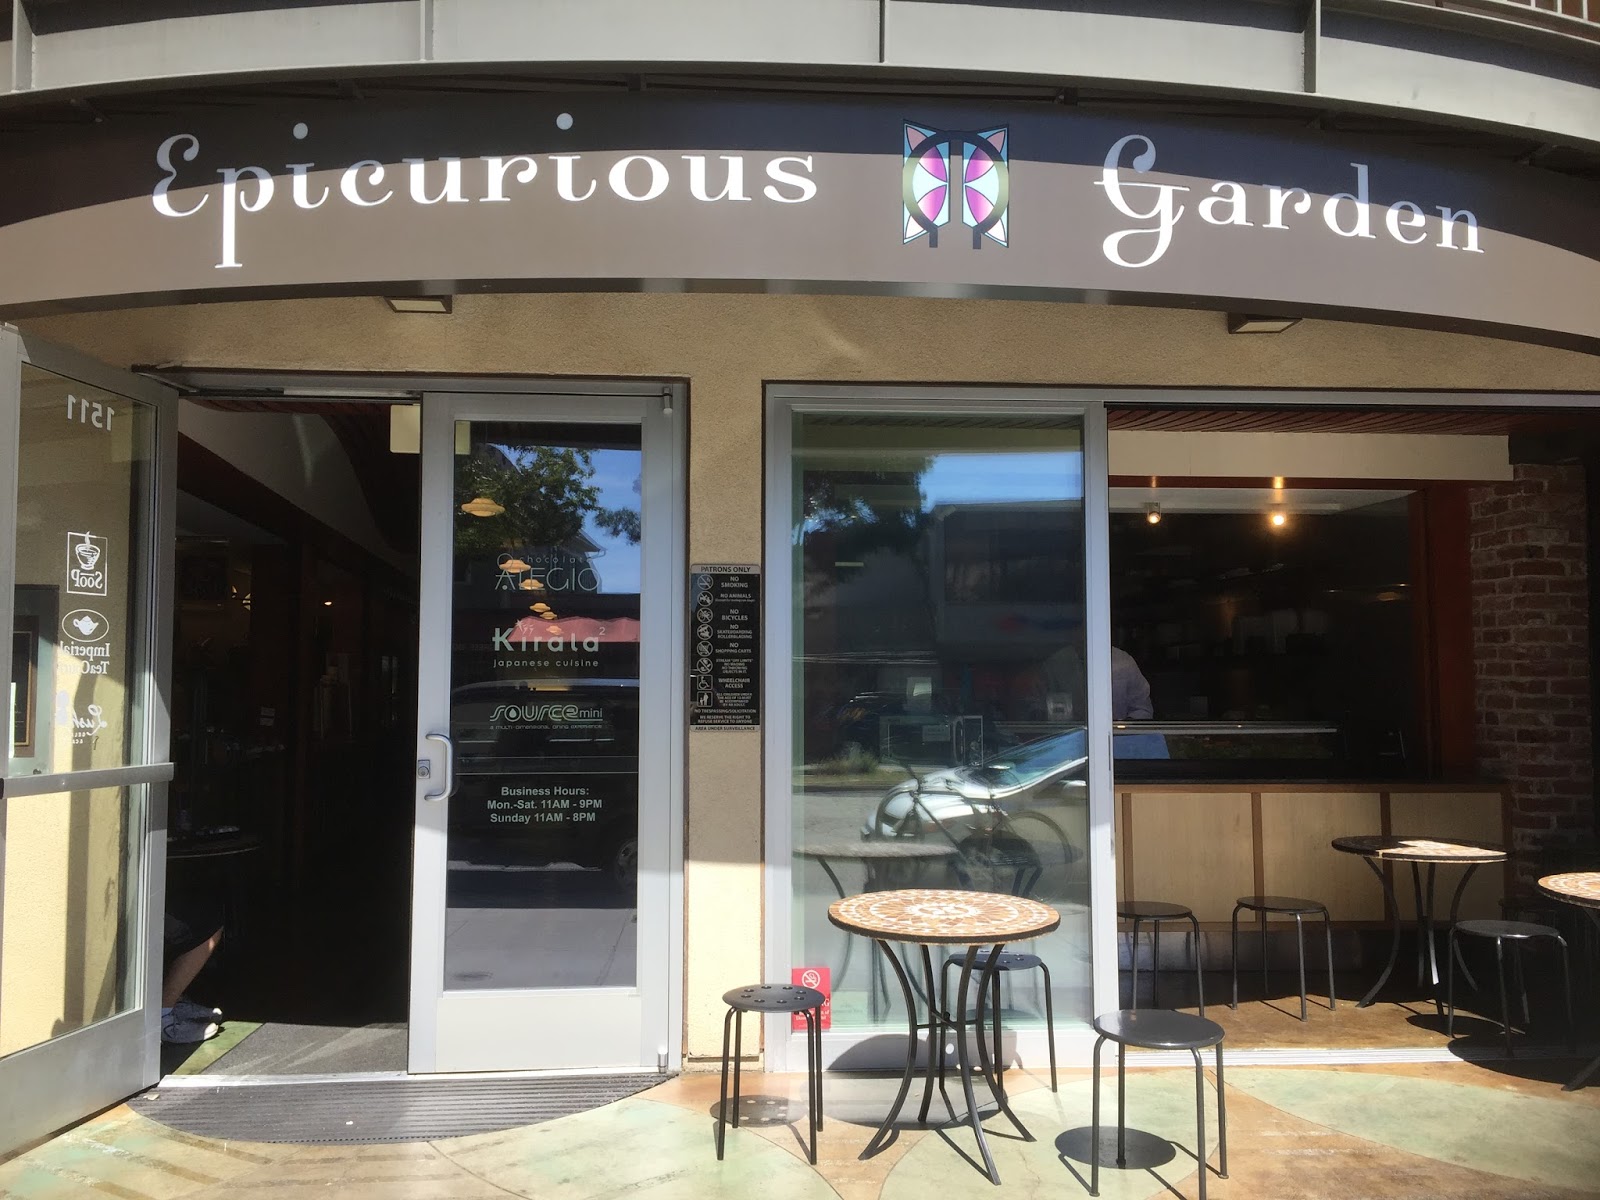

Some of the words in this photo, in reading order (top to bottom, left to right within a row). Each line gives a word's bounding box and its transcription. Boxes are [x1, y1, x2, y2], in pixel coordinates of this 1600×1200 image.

[151, 112, 819, 270] Epicurious
[1094, 133, 1485, 269] Garden
[492, 622, 599, 652] Kirala
[493, 659, 550, 668] japanese
[555, 659, 599, 667] cuisine
[501, 786, 551, 796] Business
[553, 786, 590, 796] Hours:
[487, 799, 538, 810] Mon.-Sat.
[540, 799, 571, 809] 11AM
[579, 799, 603, 809] 9PM
[490, 812, 531, 825] Sunday
[534, 812, 564, 822] 11AM
[572, 812, 597, 822] 8PM
